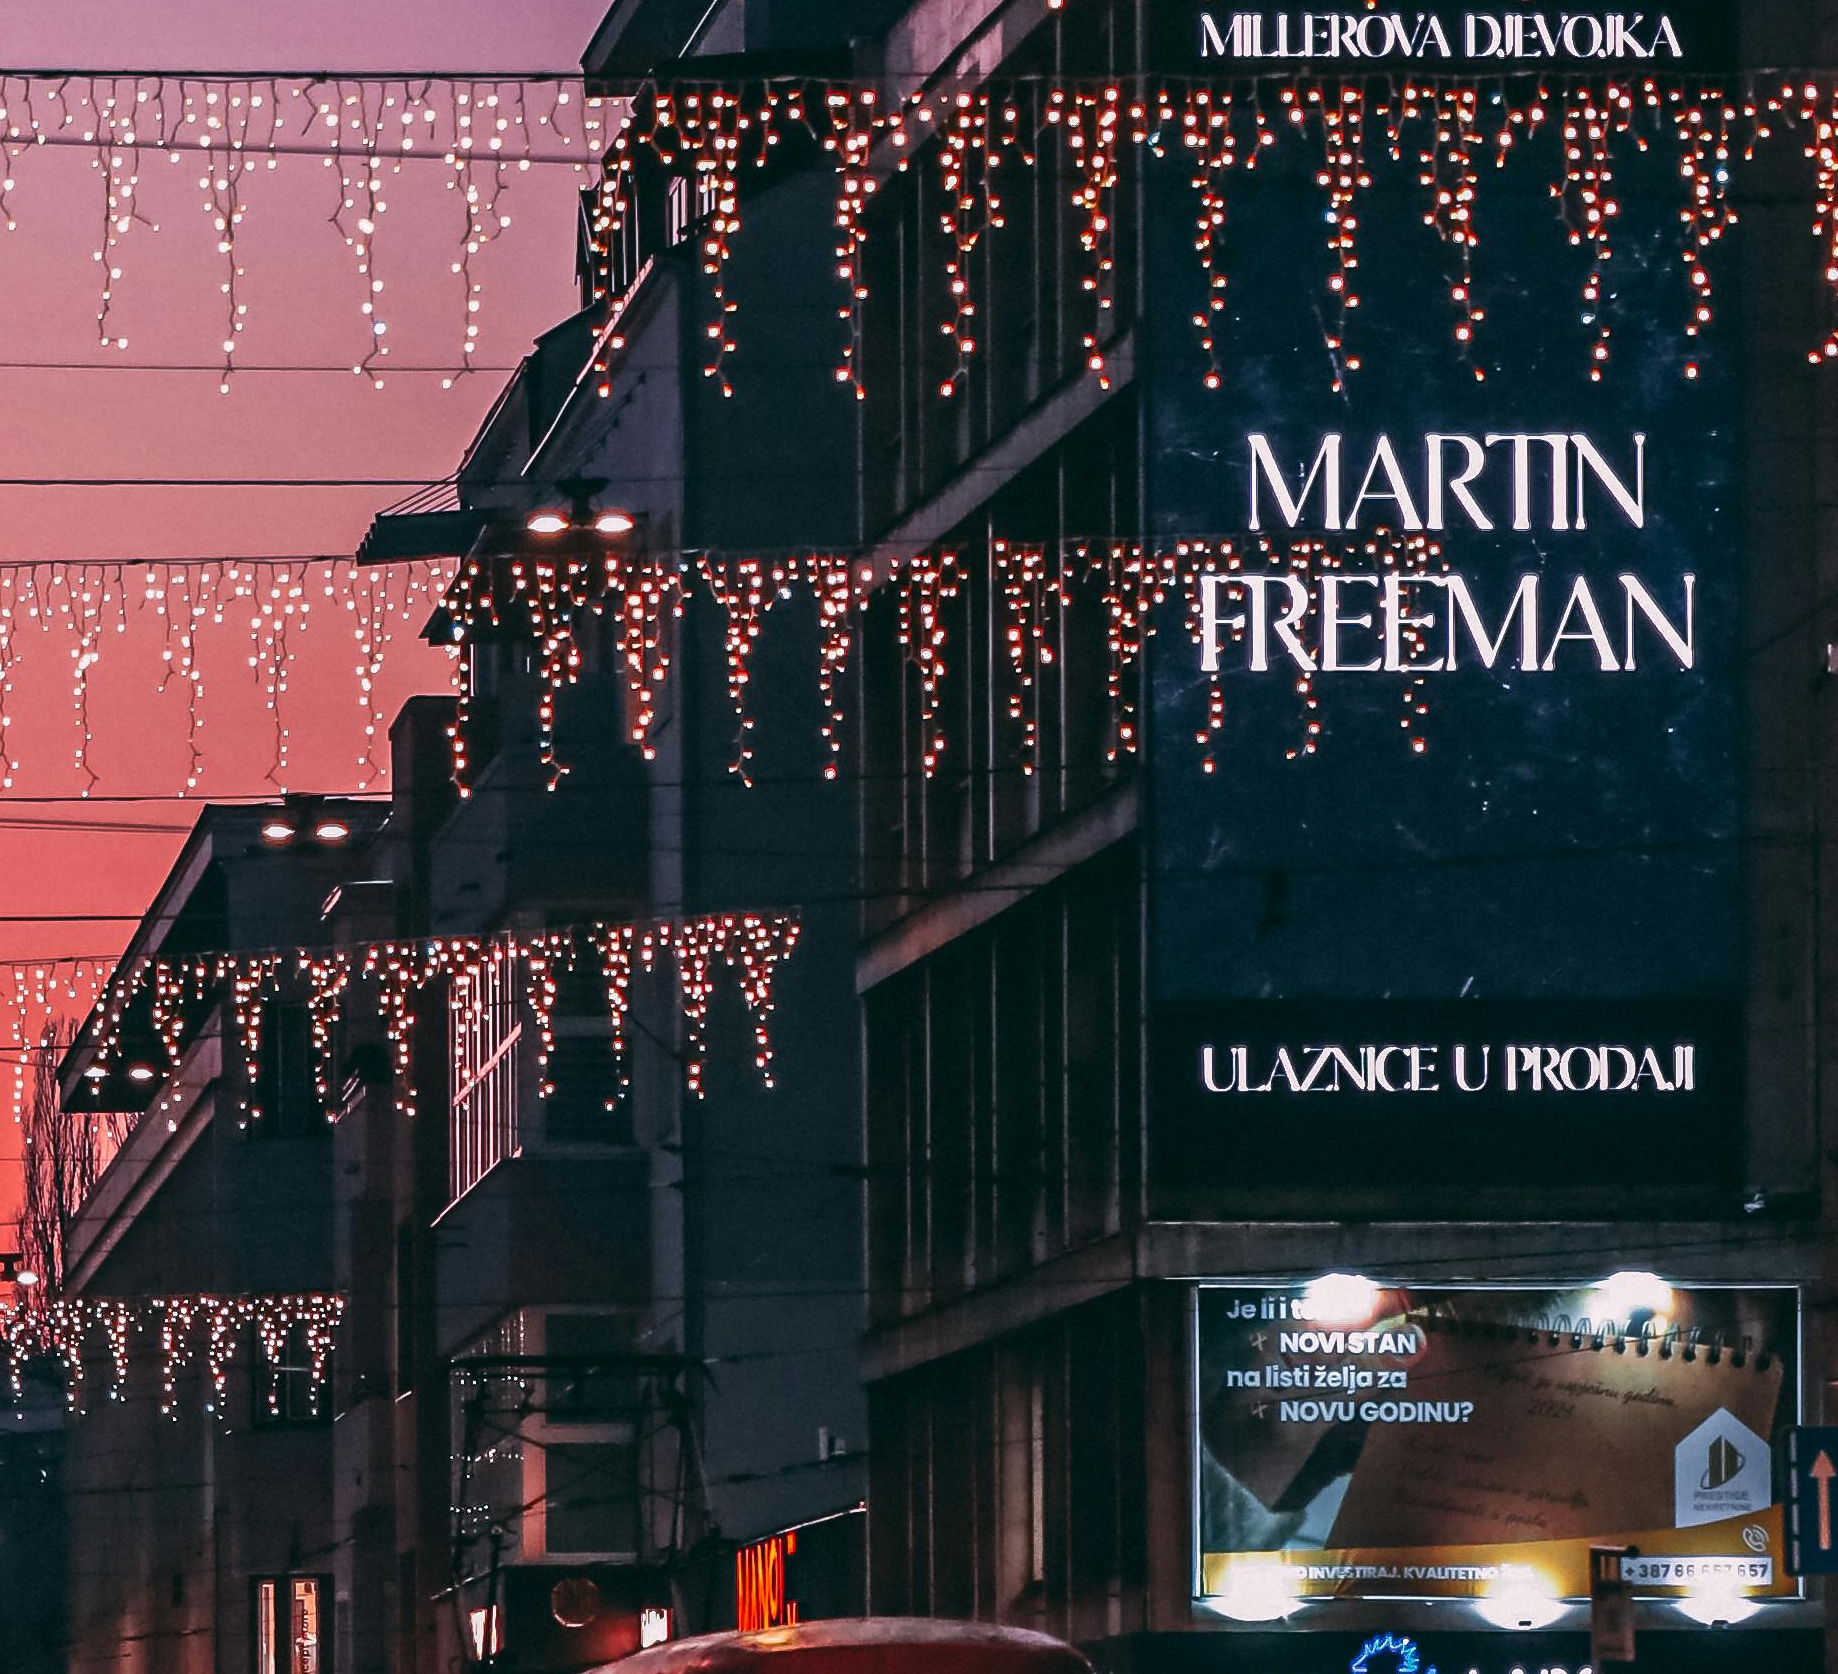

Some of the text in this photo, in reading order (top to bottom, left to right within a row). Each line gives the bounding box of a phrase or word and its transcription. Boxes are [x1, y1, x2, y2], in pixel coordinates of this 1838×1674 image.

[1200, 13, 1683, 59] MILLEROVA DJEVOJKA
[1247, 432, 1647, 531] MARTIN
[1199, 573, 1696, 673] FREEMAN
[1203, 1044, 1694, 1092] ULAZNICE U PRODAJI
[1226, 1299, 1257, 1320] Je
[1279, 1331, 1417, 1354] NOVI STAN
[1226, 1365, 1408, 1395] na listi želja za
[1280, 1400, 1476, 1423] NOVU GODINU?
